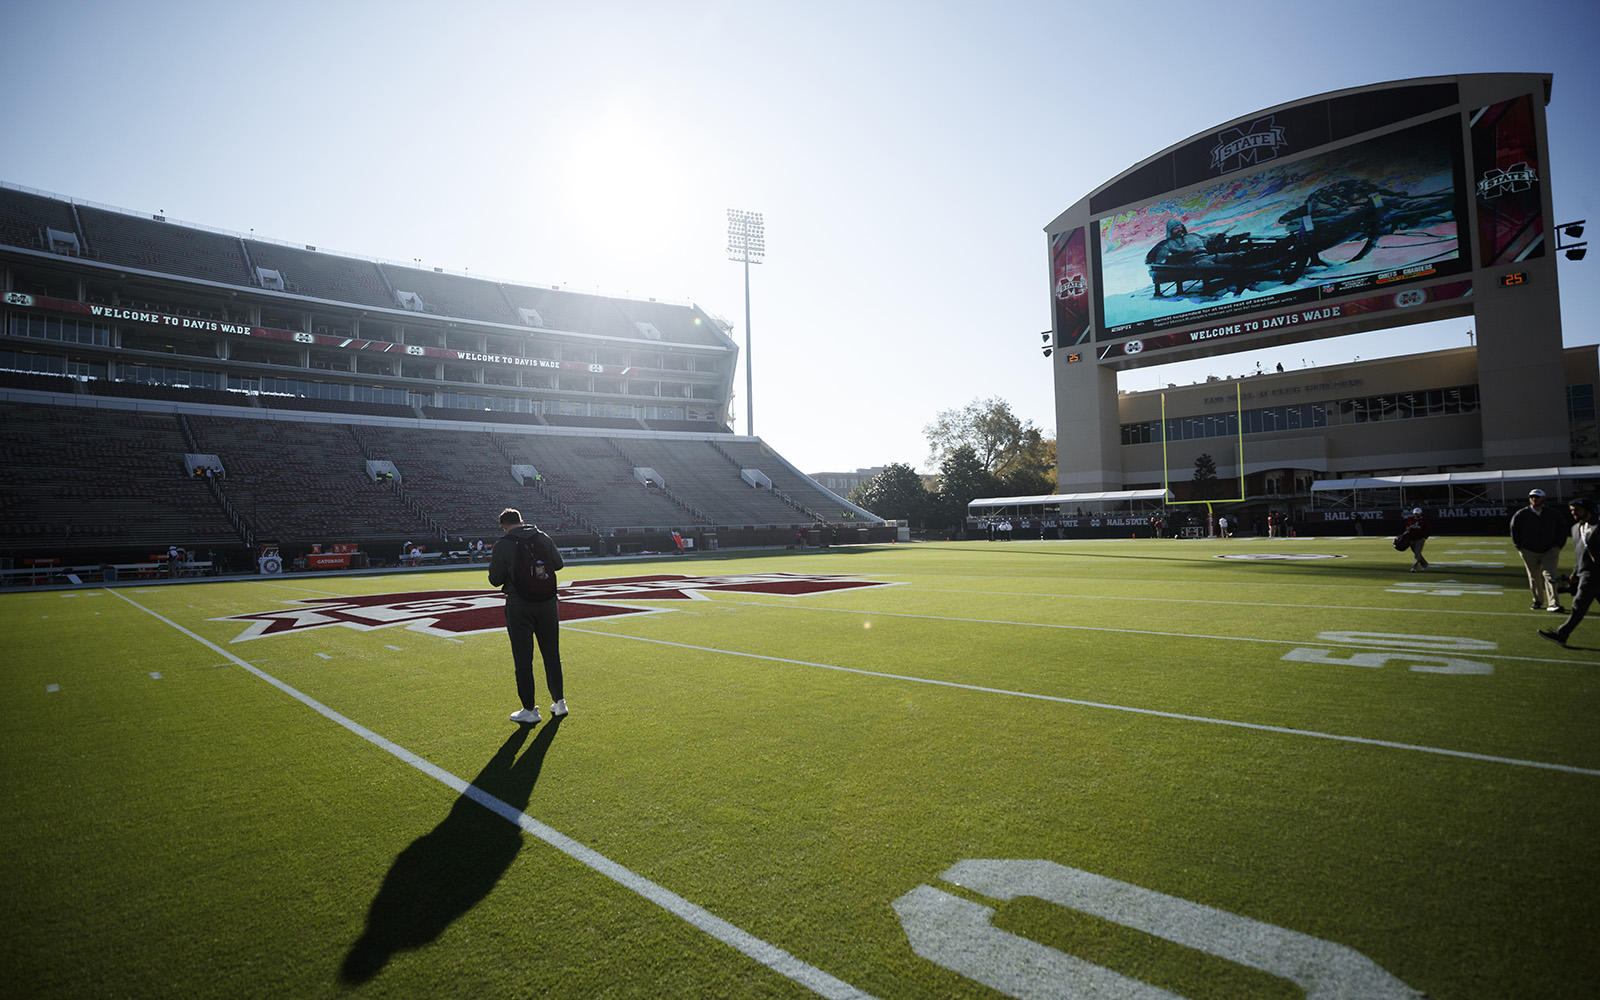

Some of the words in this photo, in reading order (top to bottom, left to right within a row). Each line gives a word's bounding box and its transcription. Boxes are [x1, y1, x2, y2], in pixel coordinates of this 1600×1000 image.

[1223, 134, 1271, 157] STATE
[1486, 172, 1525, 187] STATE
[1505, 272, 1523, 286] 25
[90, 305, 159, 323] WELCOME
[163, 316, 179, 326] TO
[182, 318, 218, 331] DAVIS
[220, 324, 251, 335] WADE
[1190, 324, 1241, 341] WELCOME
[1244, 321, 1259, 332] TO
[1262, 314, 1299, 329] DAVIS
[1302, 306, 1341, 321] WADE
[457, 351, 500, 363] WELCOME
[502, 356, 513, 364] TO
[514, 358, 538, 367] DAVIS
[539, 360, 560, 368] WADE
[1069, 353, 1079, 362] 25
[1324, 512, 1350, 521] HAIL
[1439, 508, 1468, 518] HAIL
[1470, 506, 1508, 517] STATE
[1106, 518, 1124, 526] HAIL
[1125, 517, 1148, 526] STATE
[1279, 631, 1499, 675] 50
